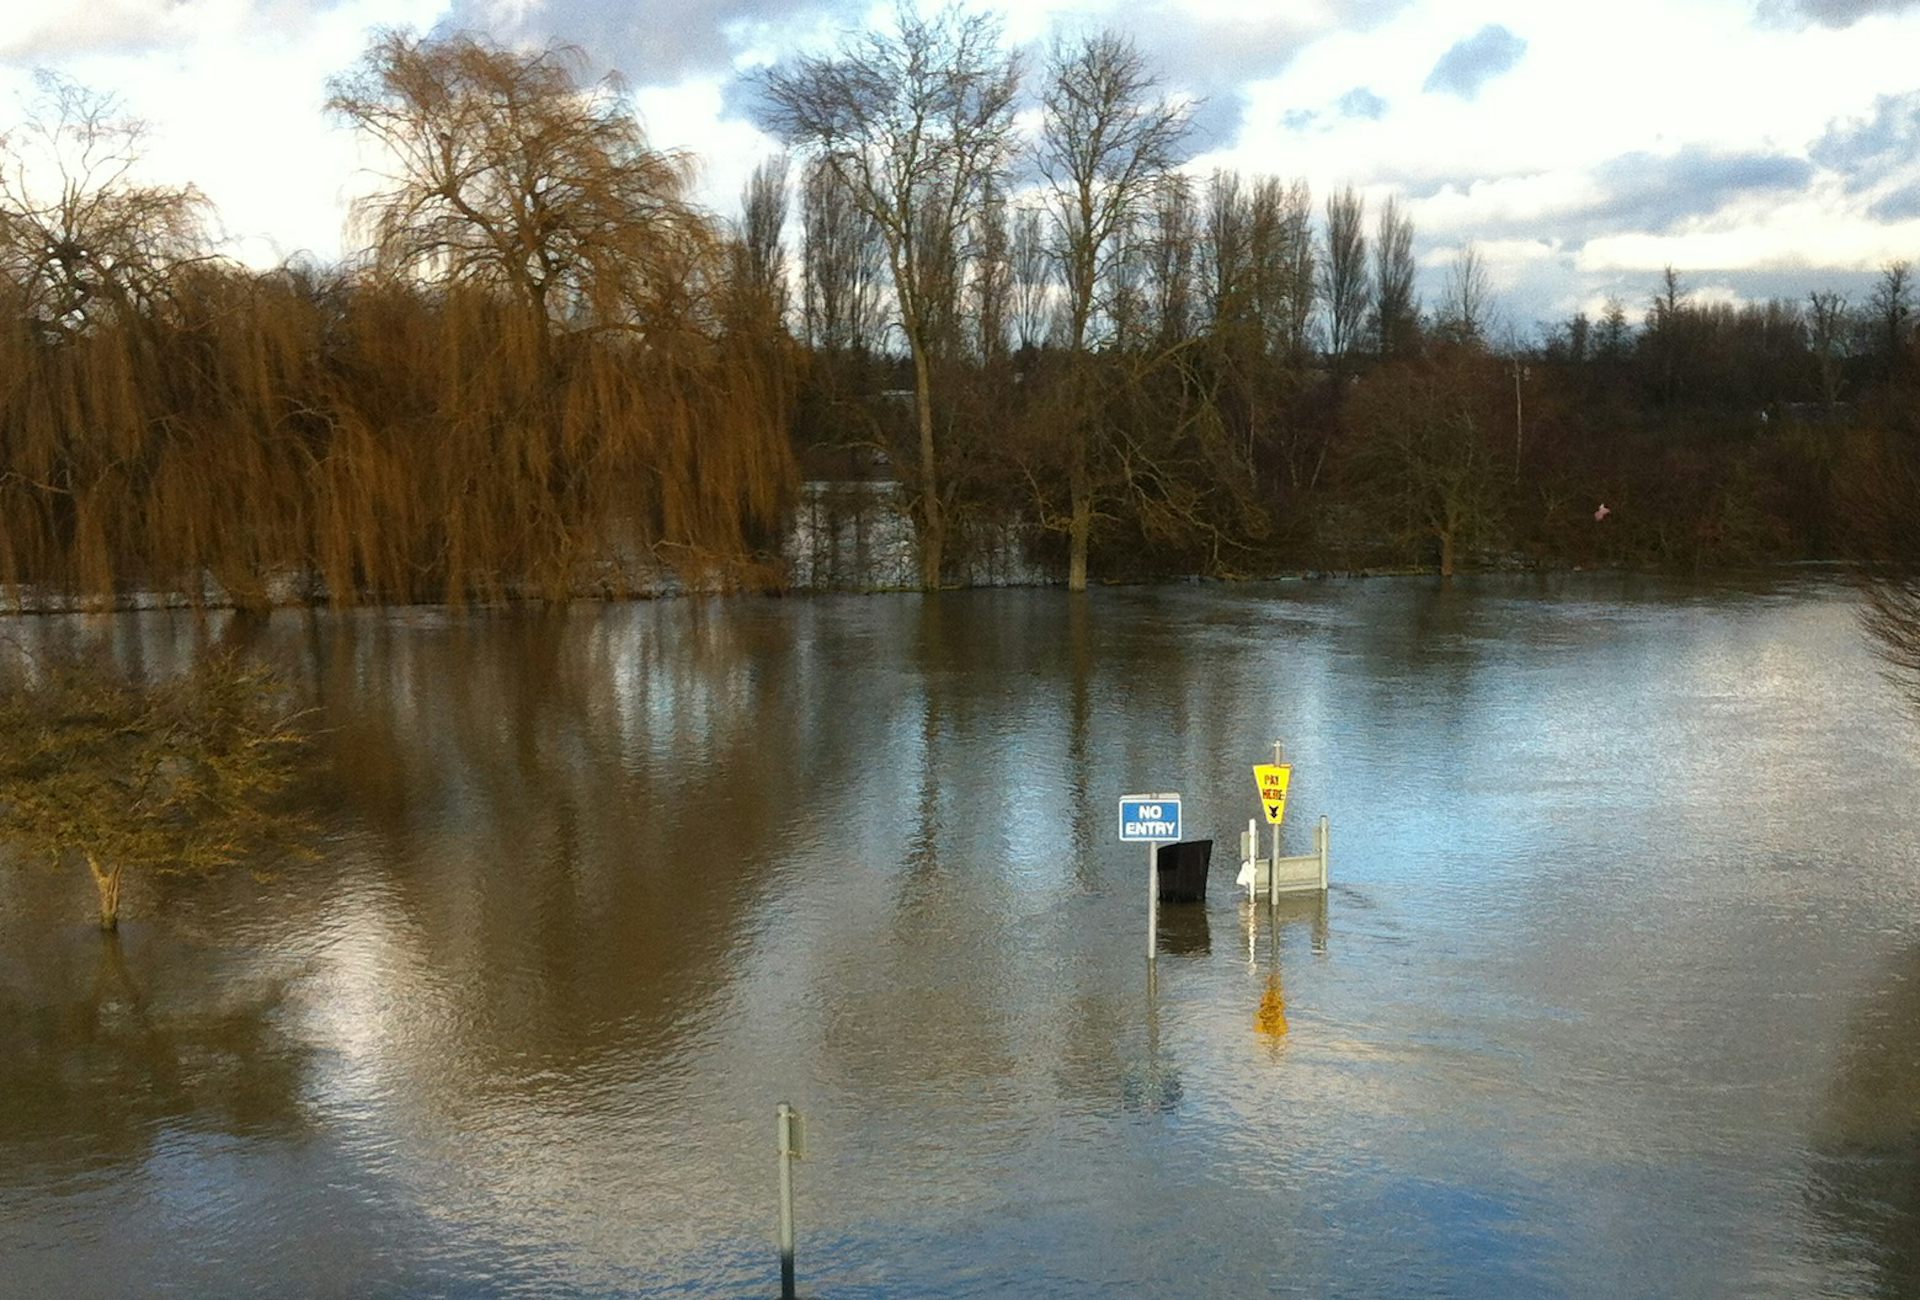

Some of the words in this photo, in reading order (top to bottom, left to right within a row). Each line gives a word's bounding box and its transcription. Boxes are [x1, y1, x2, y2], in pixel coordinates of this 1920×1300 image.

[1264, 774, 1279, 785] PAY
[1263, 789, 1285, 800] HERE
[1139, 805, 1162, 819] NO
[1125, 822, 1175, 835] ENTRY
